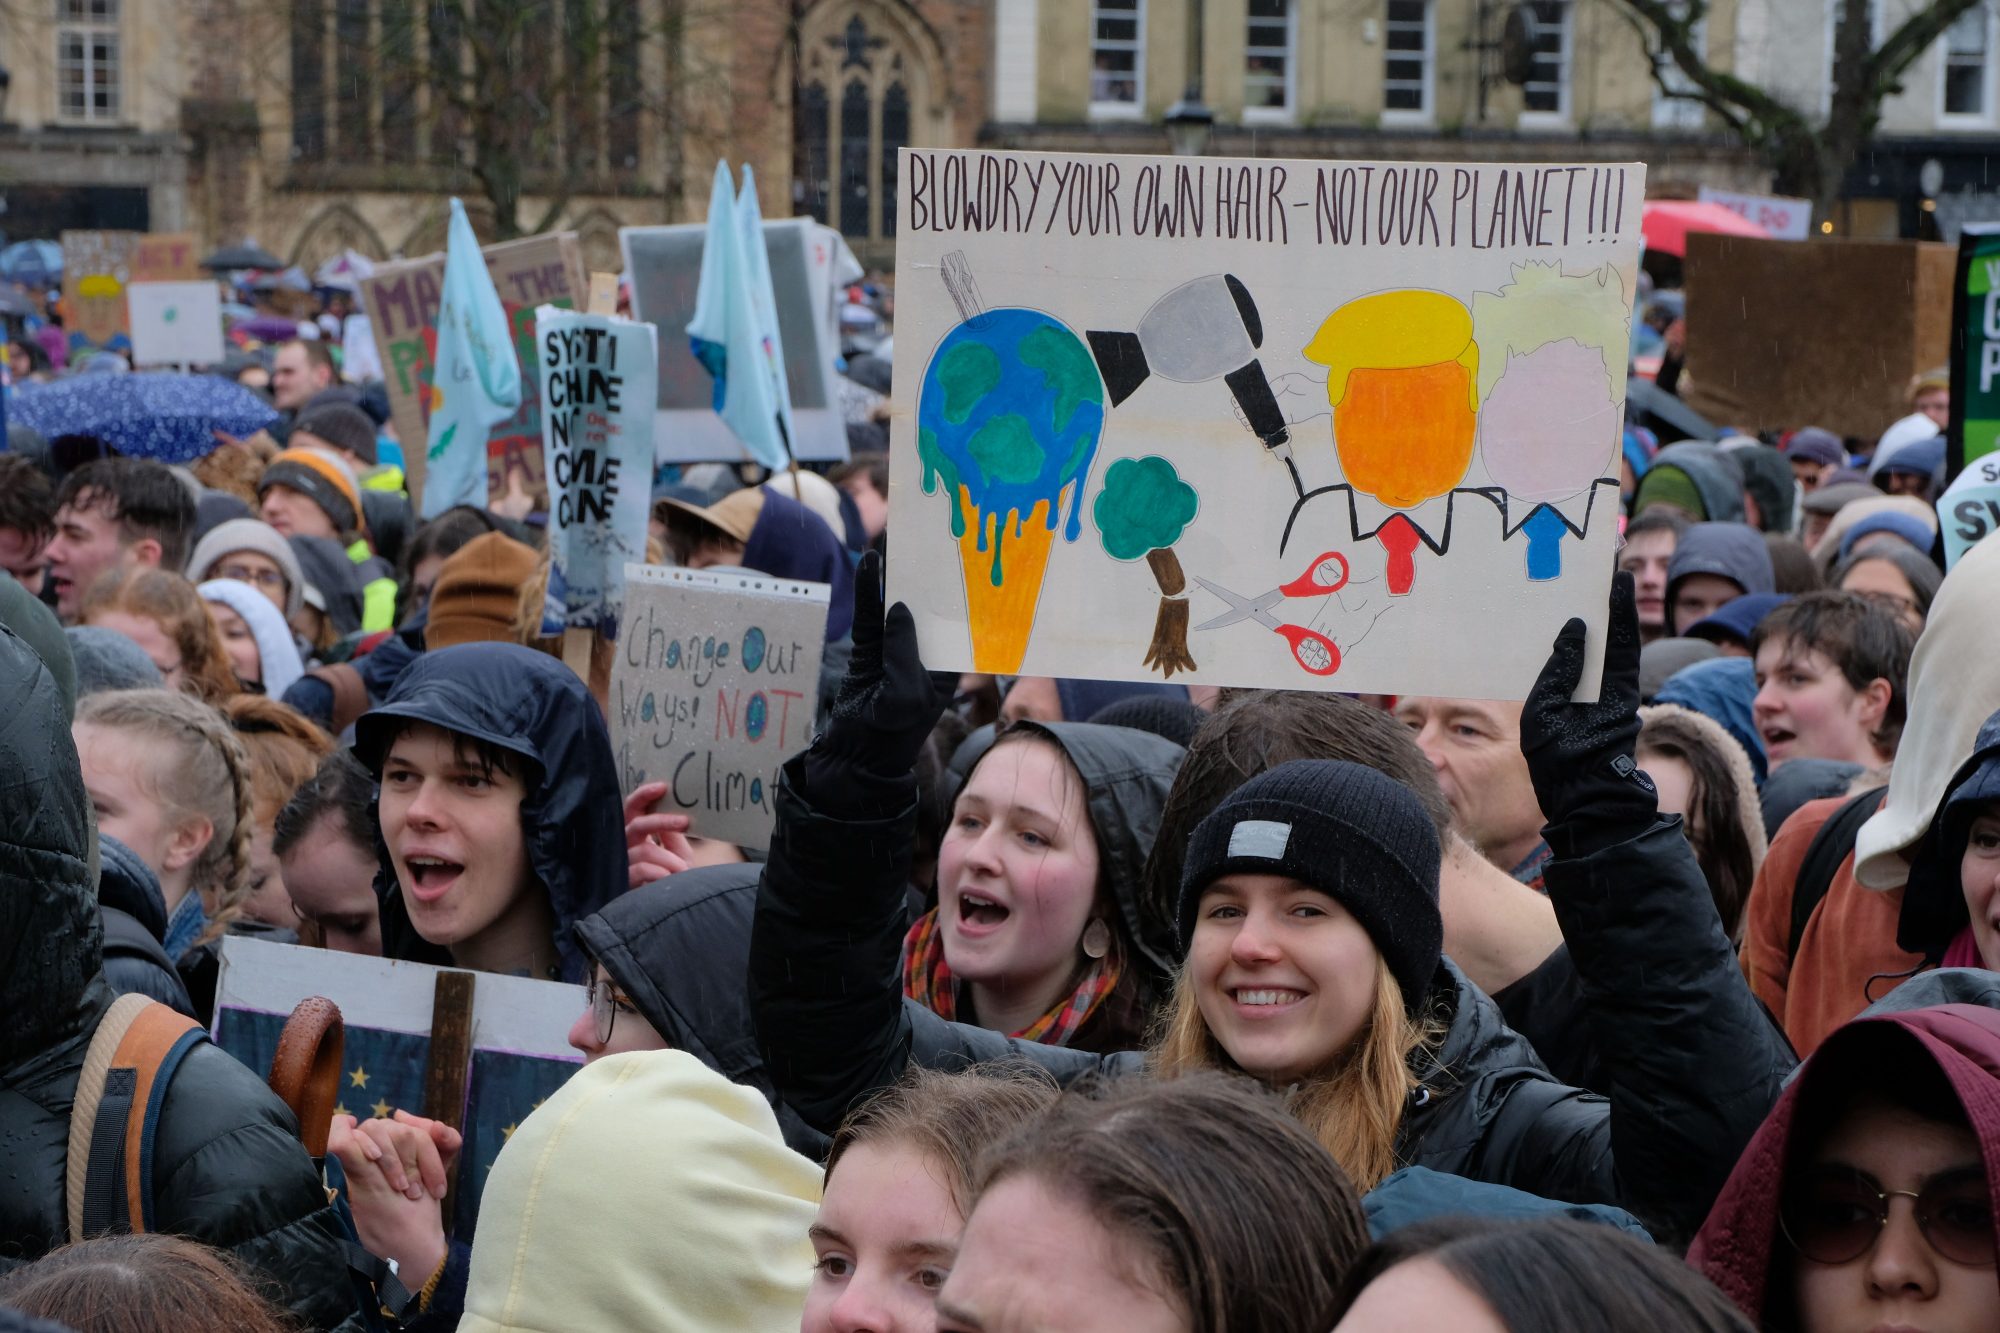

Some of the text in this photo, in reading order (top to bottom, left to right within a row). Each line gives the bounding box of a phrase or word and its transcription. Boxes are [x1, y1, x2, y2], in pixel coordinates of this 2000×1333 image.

[1045, 161, 1121, 236] YOUR
[1133, 164, 1204, 238] OWN
[1317, 167, 1375, 245] NOT
[1378, 168, 1440, 247] OUR
[508, 262, 570, 302] THE
[627, 606, 802, 688] Change Our
[619, 679, 804, 749] Ways! NOT
[672, 750, 780, 815] Climat
